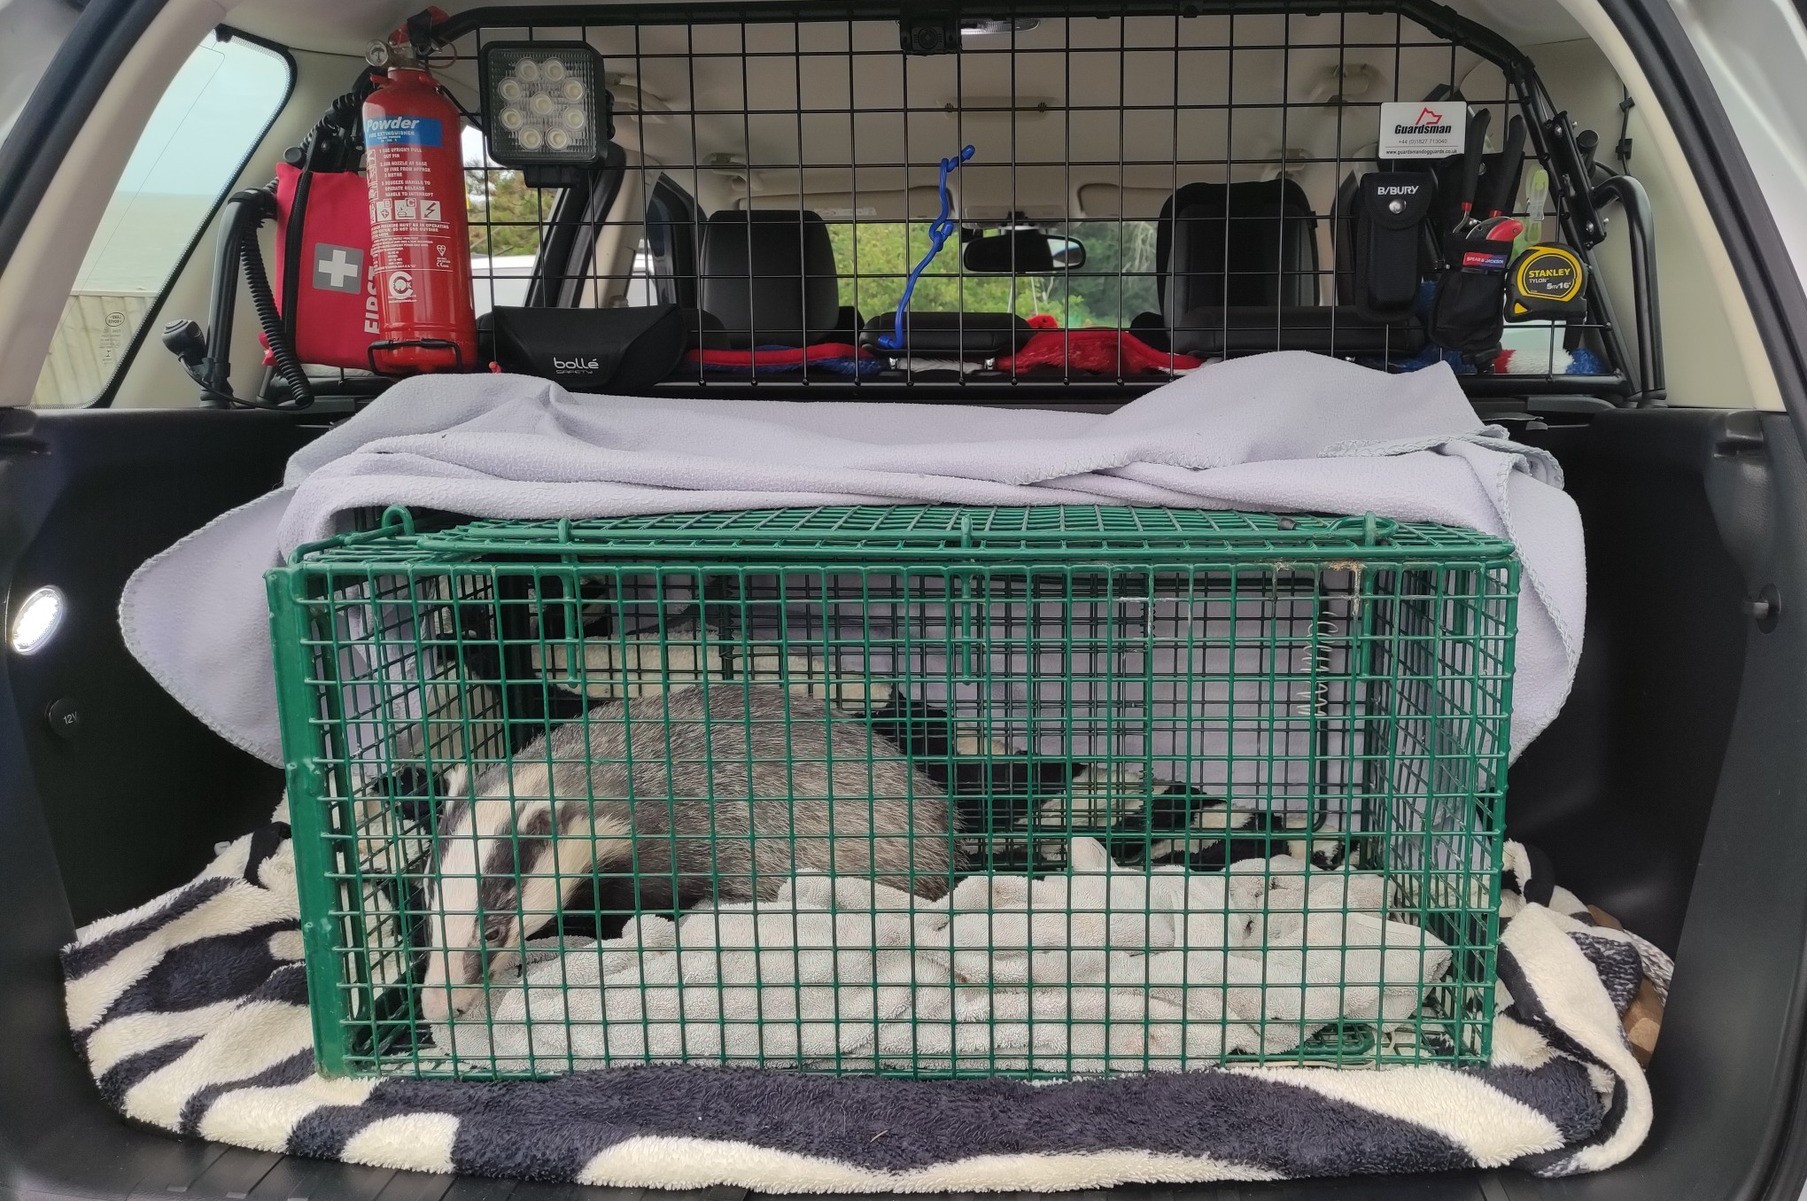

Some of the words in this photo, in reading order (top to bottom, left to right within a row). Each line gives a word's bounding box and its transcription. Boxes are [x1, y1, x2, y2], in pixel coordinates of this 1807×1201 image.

[367, 116, 420, 132] Powder
[1395, 125, 1452, 135] Guardsman
[1529, 268, 1571, 278] STANLEY
[553, 356, 599, 369] bollé
